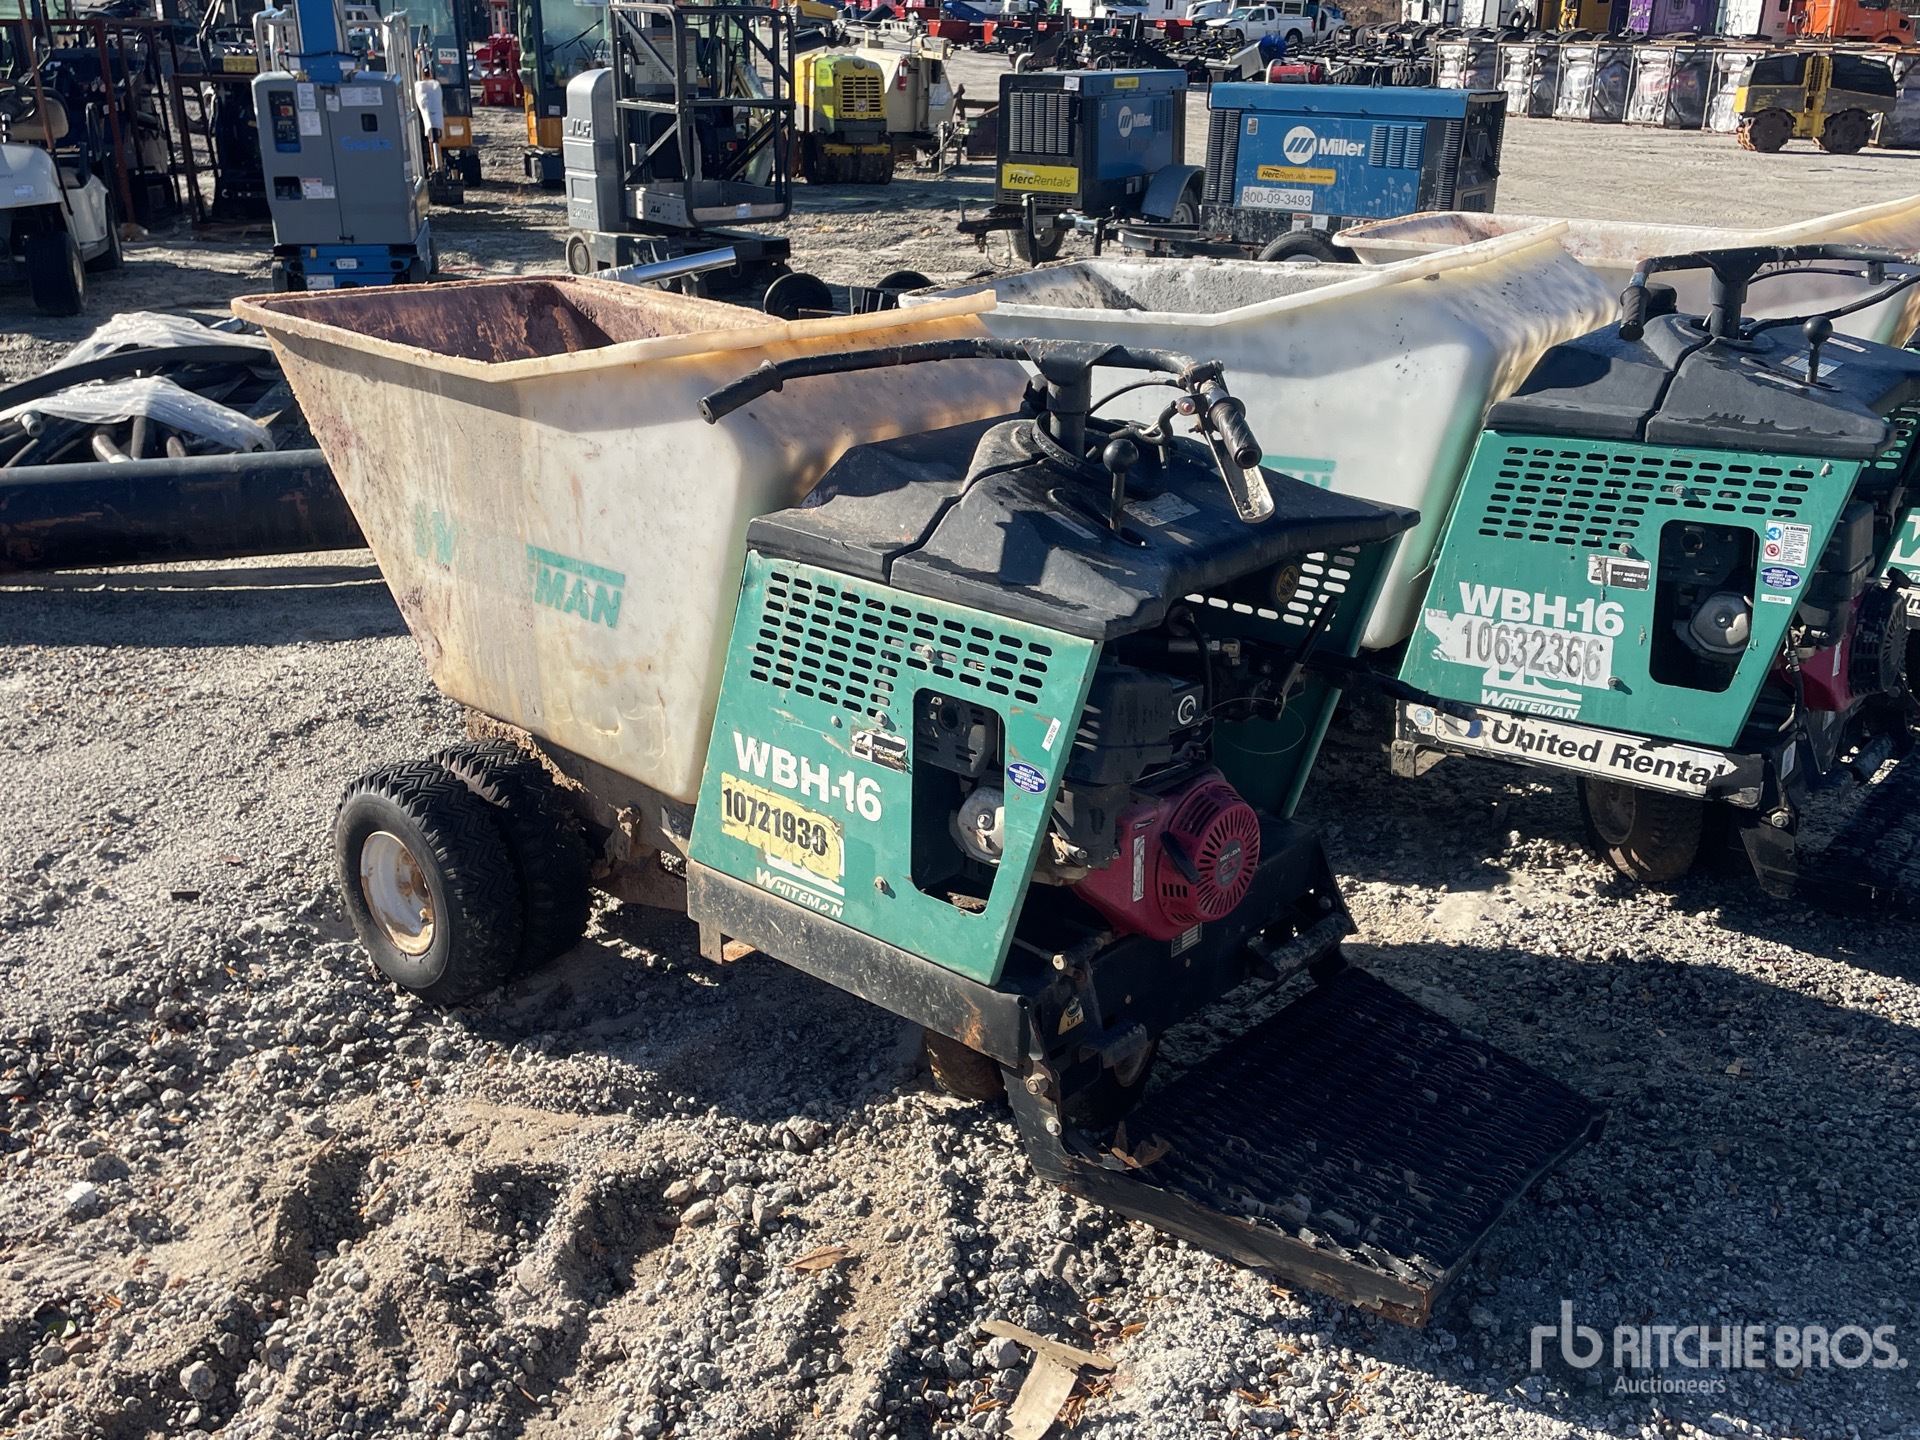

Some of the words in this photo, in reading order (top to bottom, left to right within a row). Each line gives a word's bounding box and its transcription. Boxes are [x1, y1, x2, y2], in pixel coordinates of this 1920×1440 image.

[1133, 113, 1152, 127] Miller
[1318, 138, 1365, 157] Miller
[1009, 173, 1072, 188] HercRentals
[1243, 191, 1312, 207] 800-09-3493
[1458, 581, 1625, 637] WBH-16
[1461, 618, 1602, 681] 10632366
[1481, 688, 1581, 720] WHITEMAN
[1491, 720, 1603, 763] United
[732, 730, 883, 822] WBH-16
[722, 787, 829, 857] 10721930
